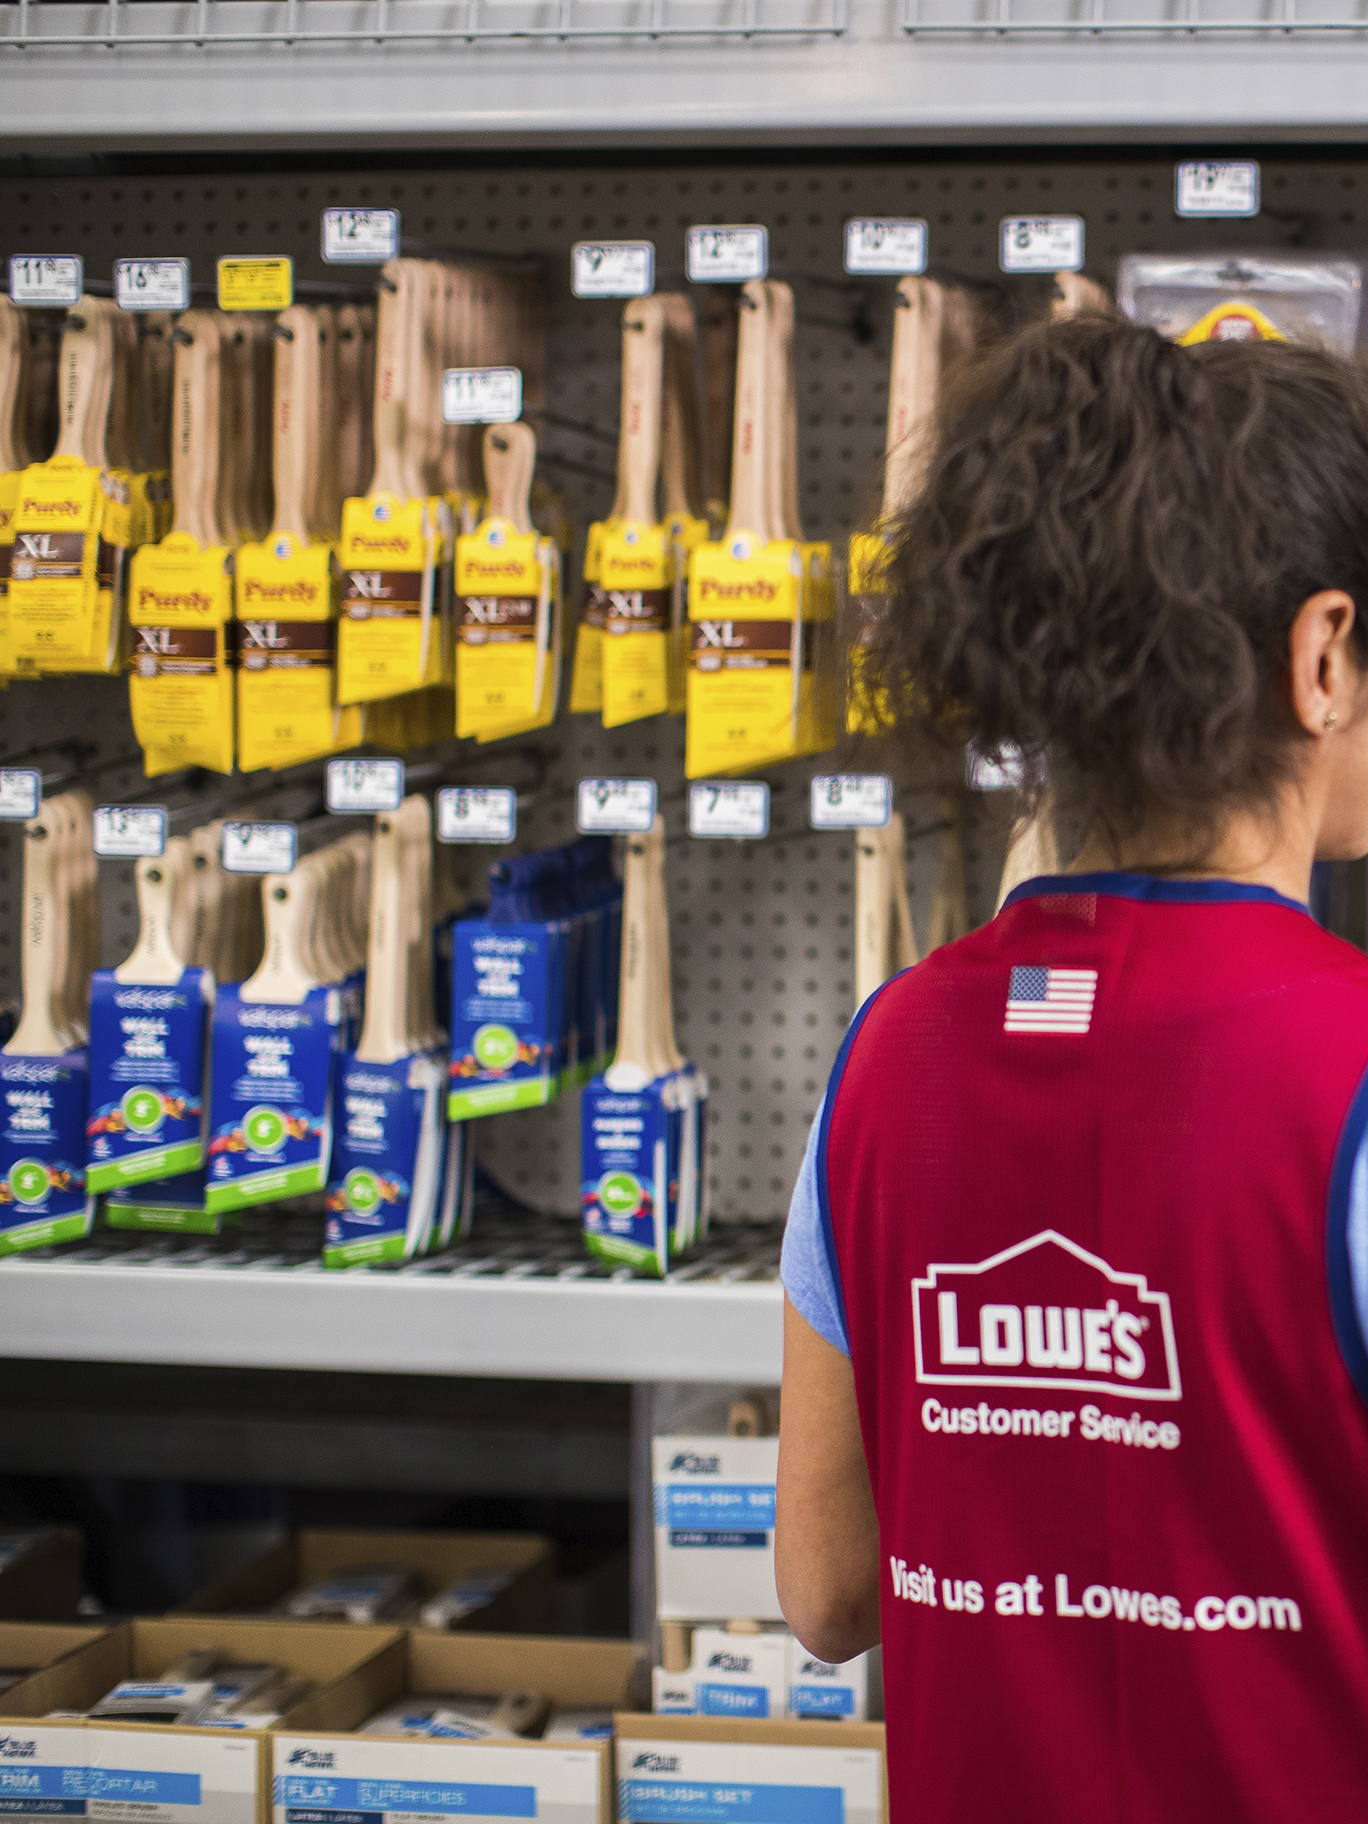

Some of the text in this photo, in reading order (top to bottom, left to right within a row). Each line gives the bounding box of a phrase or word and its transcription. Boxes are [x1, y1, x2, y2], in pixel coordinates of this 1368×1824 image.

[17, 533, 59, 559] XL
[347, 572, 391, 598] XL
[606, 590, 654, 617] XL
[136, 626, 181, 654] XL
[242, 621, 290, 649] XL
[697, 620, 745, 648] XL
[937, 1291, 1147, 1381] LOWE'S
[920, 1398, 1182, 1450] Customer Service
[889, 1555, 1303, 1632] Visit us at Lowes.com
